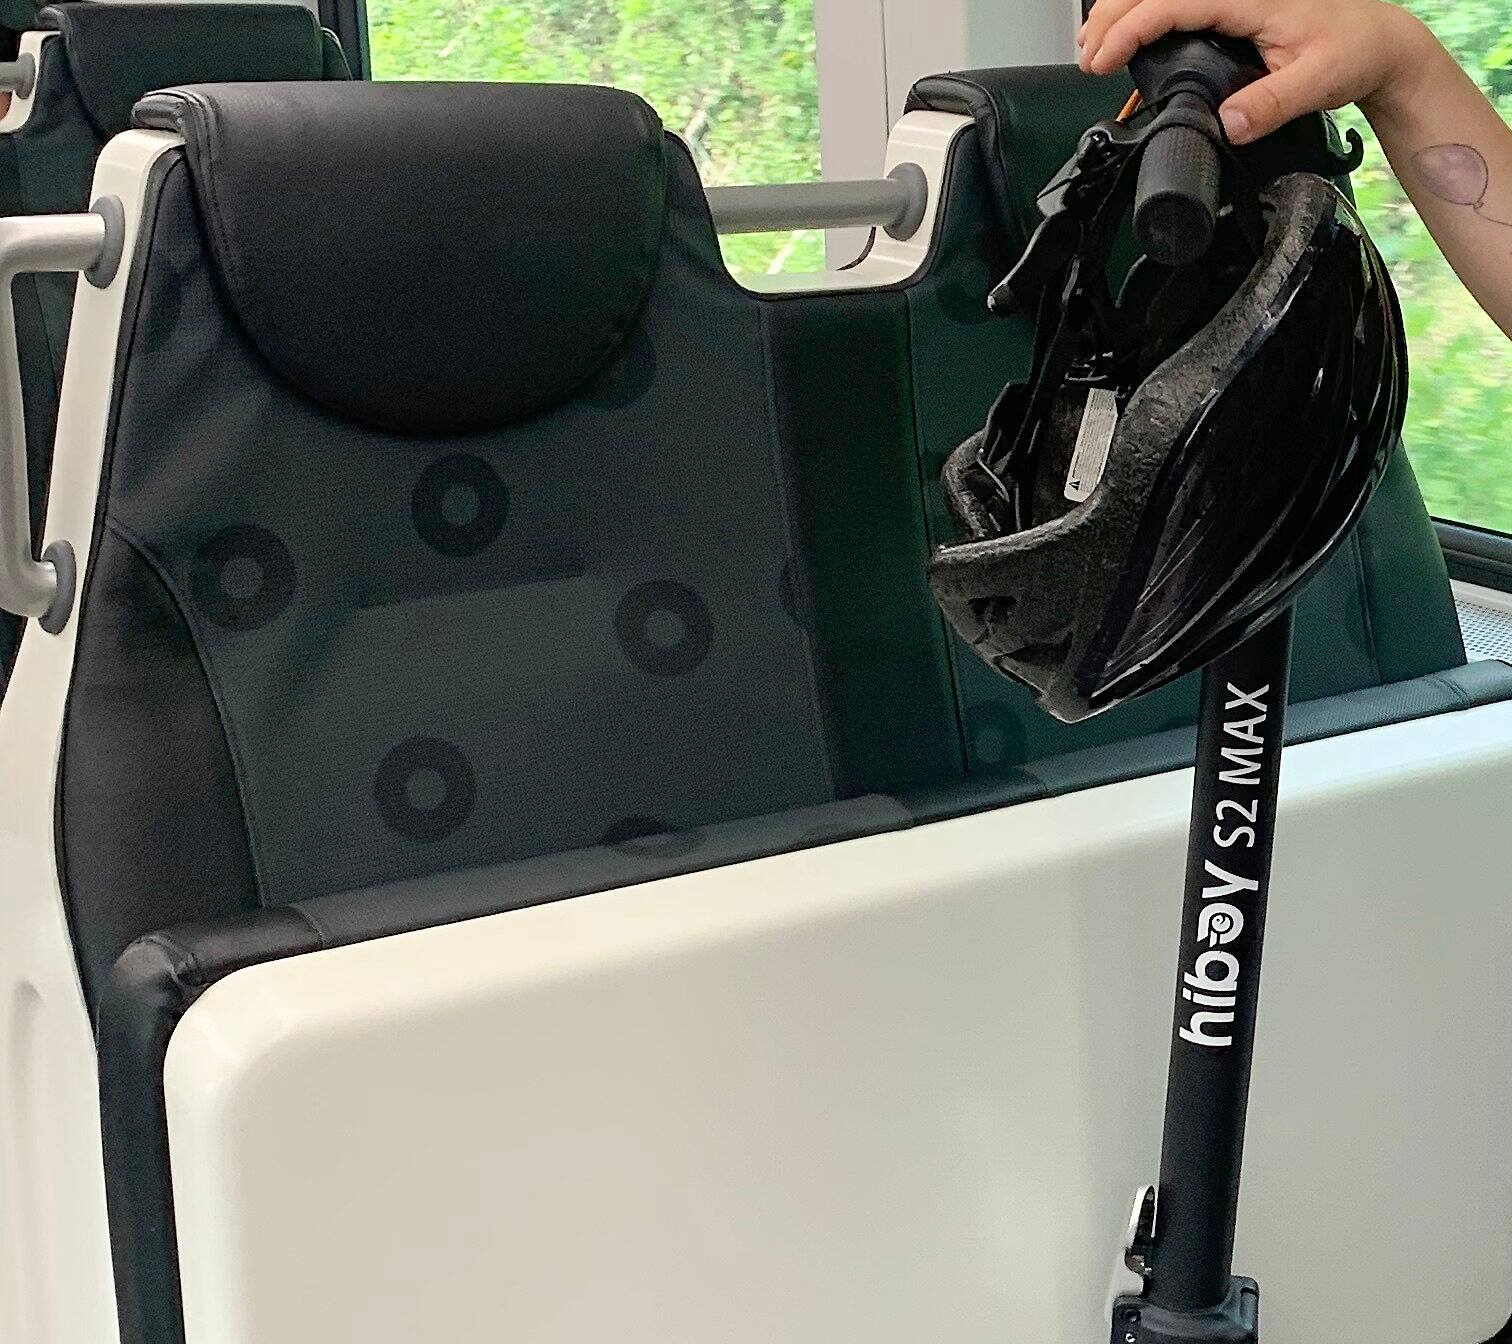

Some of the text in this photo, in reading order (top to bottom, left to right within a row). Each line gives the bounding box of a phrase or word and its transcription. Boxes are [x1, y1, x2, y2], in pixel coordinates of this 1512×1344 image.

[1178, 681, 1270, 1047] hiboy S2 MAX
